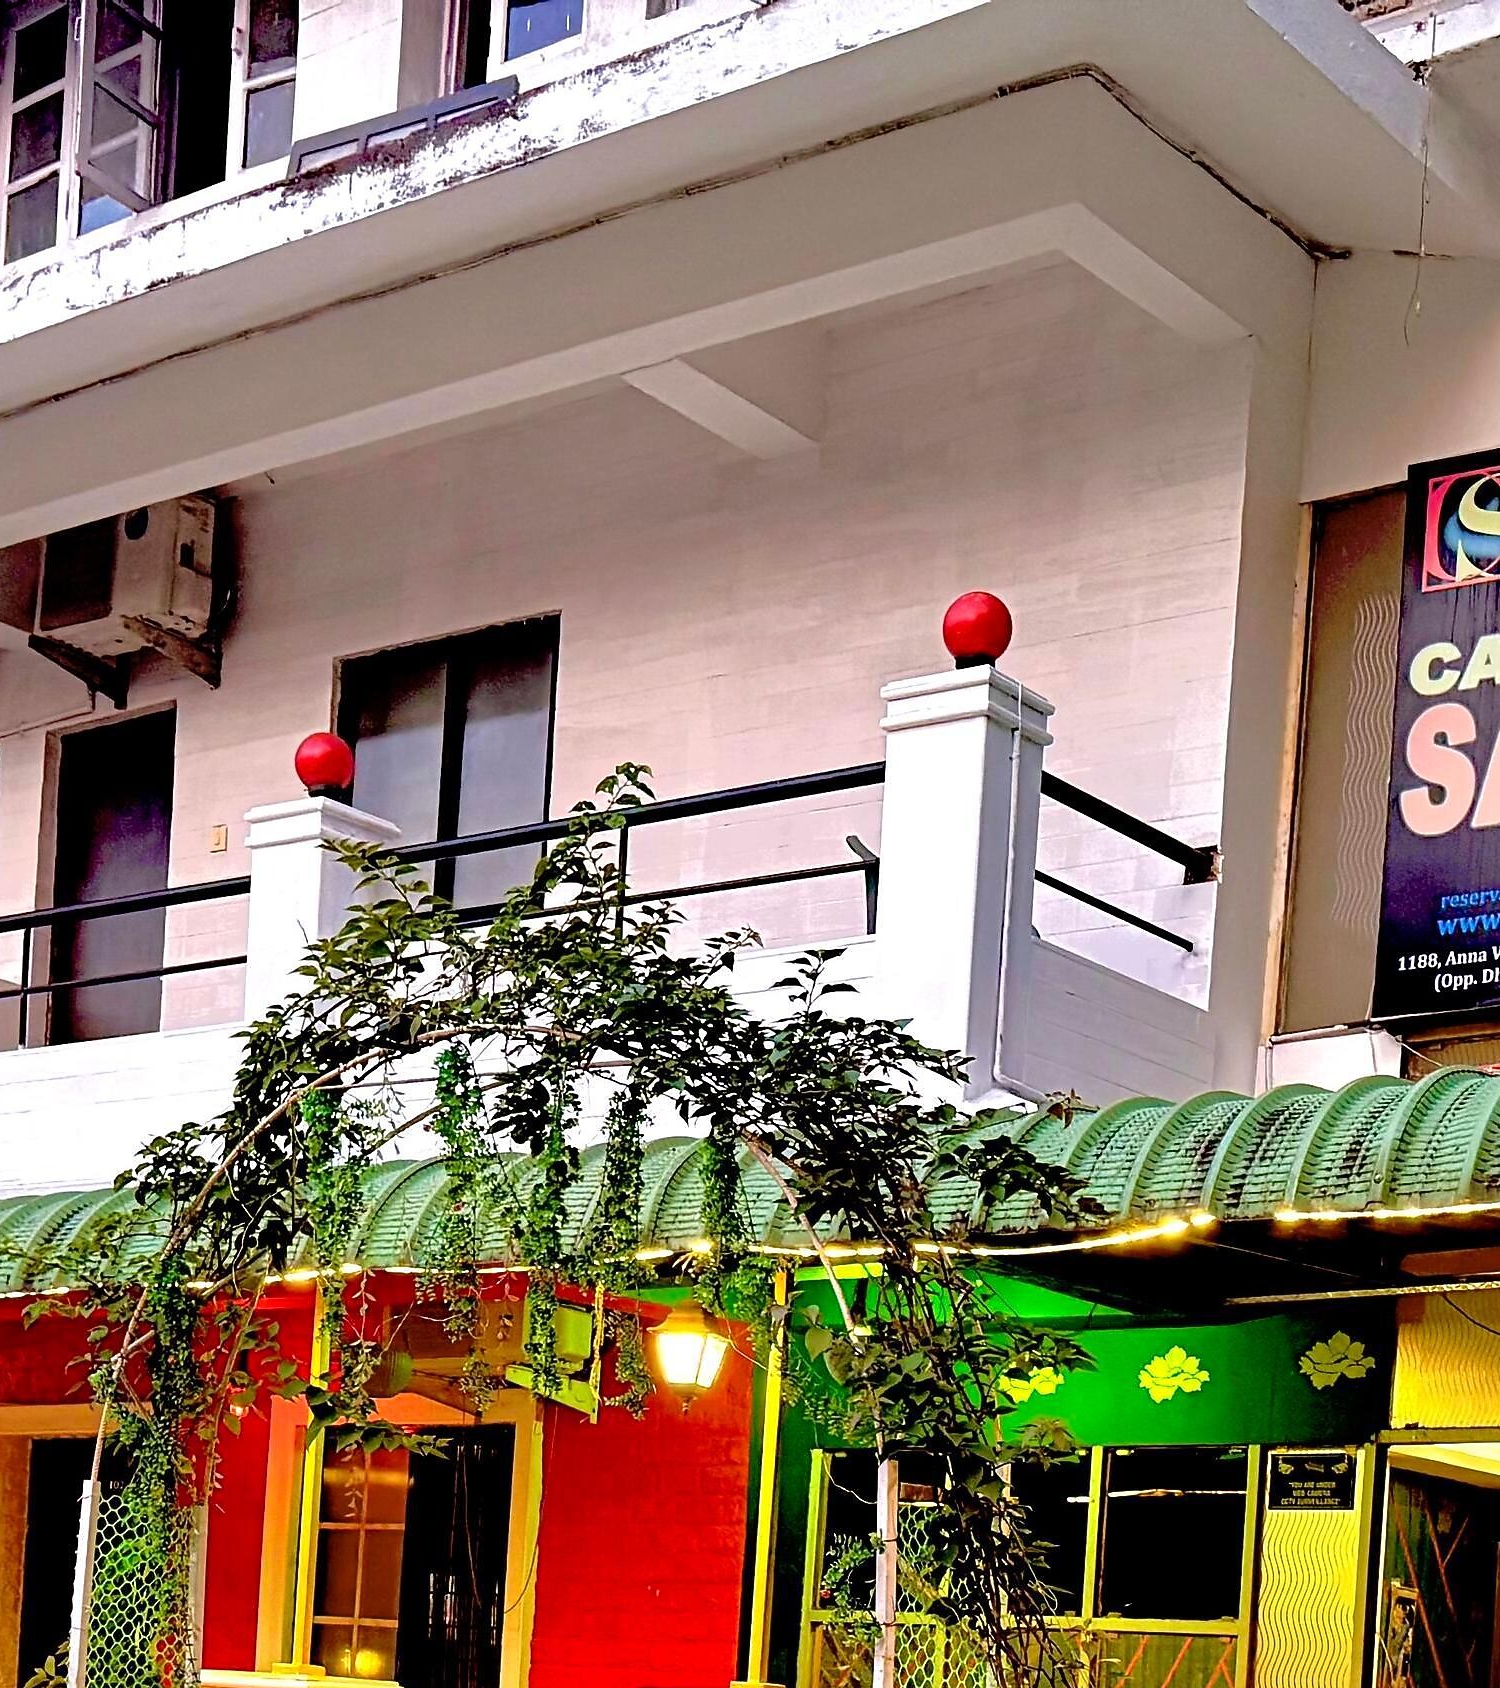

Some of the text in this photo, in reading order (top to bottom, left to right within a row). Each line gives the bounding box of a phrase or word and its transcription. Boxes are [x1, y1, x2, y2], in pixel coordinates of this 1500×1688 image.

[1398, 952, 1442, 971] 1188,
[1445, 950, 1488, 967] Anna
[1434, 973, 1478, 993] (Opp.
